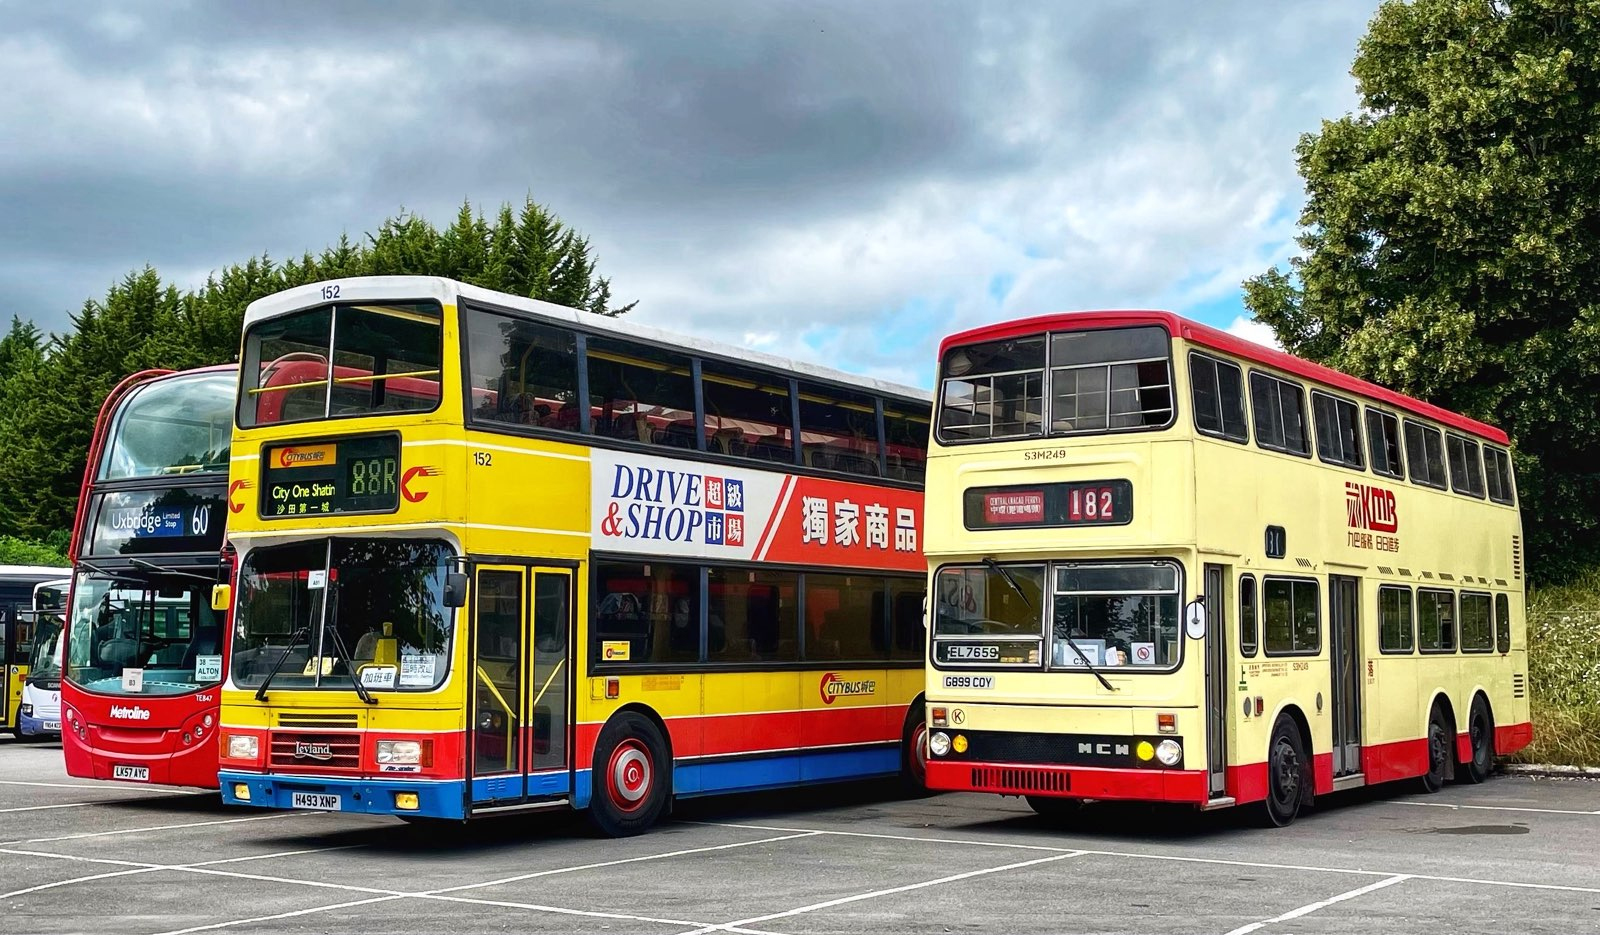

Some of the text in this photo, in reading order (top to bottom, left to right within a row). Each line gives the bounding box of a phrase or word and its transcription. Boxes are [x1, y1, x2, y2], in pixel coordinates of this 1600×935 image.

[321, 285, 340, 300] 152
[473, 452, 492, 466] 152
[1024, 450, 1066, 461] S3M249
[352, 458, 396, 496] 88R
[272, 483, 336, 502] City One Shatin
[610, 464, 702, 507] DRIVE
[1072, 490, 1113, 517] 182
[1360, 484, 1398, 534] KMB
[112, 505, 209, 535] Uxbridge 60
[163, 512, 181, 520] Limited
[165, 520, 177, 528] Stop
[706, 514, 743, 544] 市場
[802, 495, 917, 552] 獨家商品
[949, 647, 997, 658] EL7659
[198, 667, 219, 675] ALTON
[364, 672, 393, 683] 加班車
[828, 681, 861, 694] CITYBUS
[945, 676, 971, 687] G899
[110, 704, 150, 720] Metroline
[1078, 742, 1129, 756] MCW
[115, 766, 147, 778] LK57 AYC
[295, 794, 337, 808] H493 XNP
